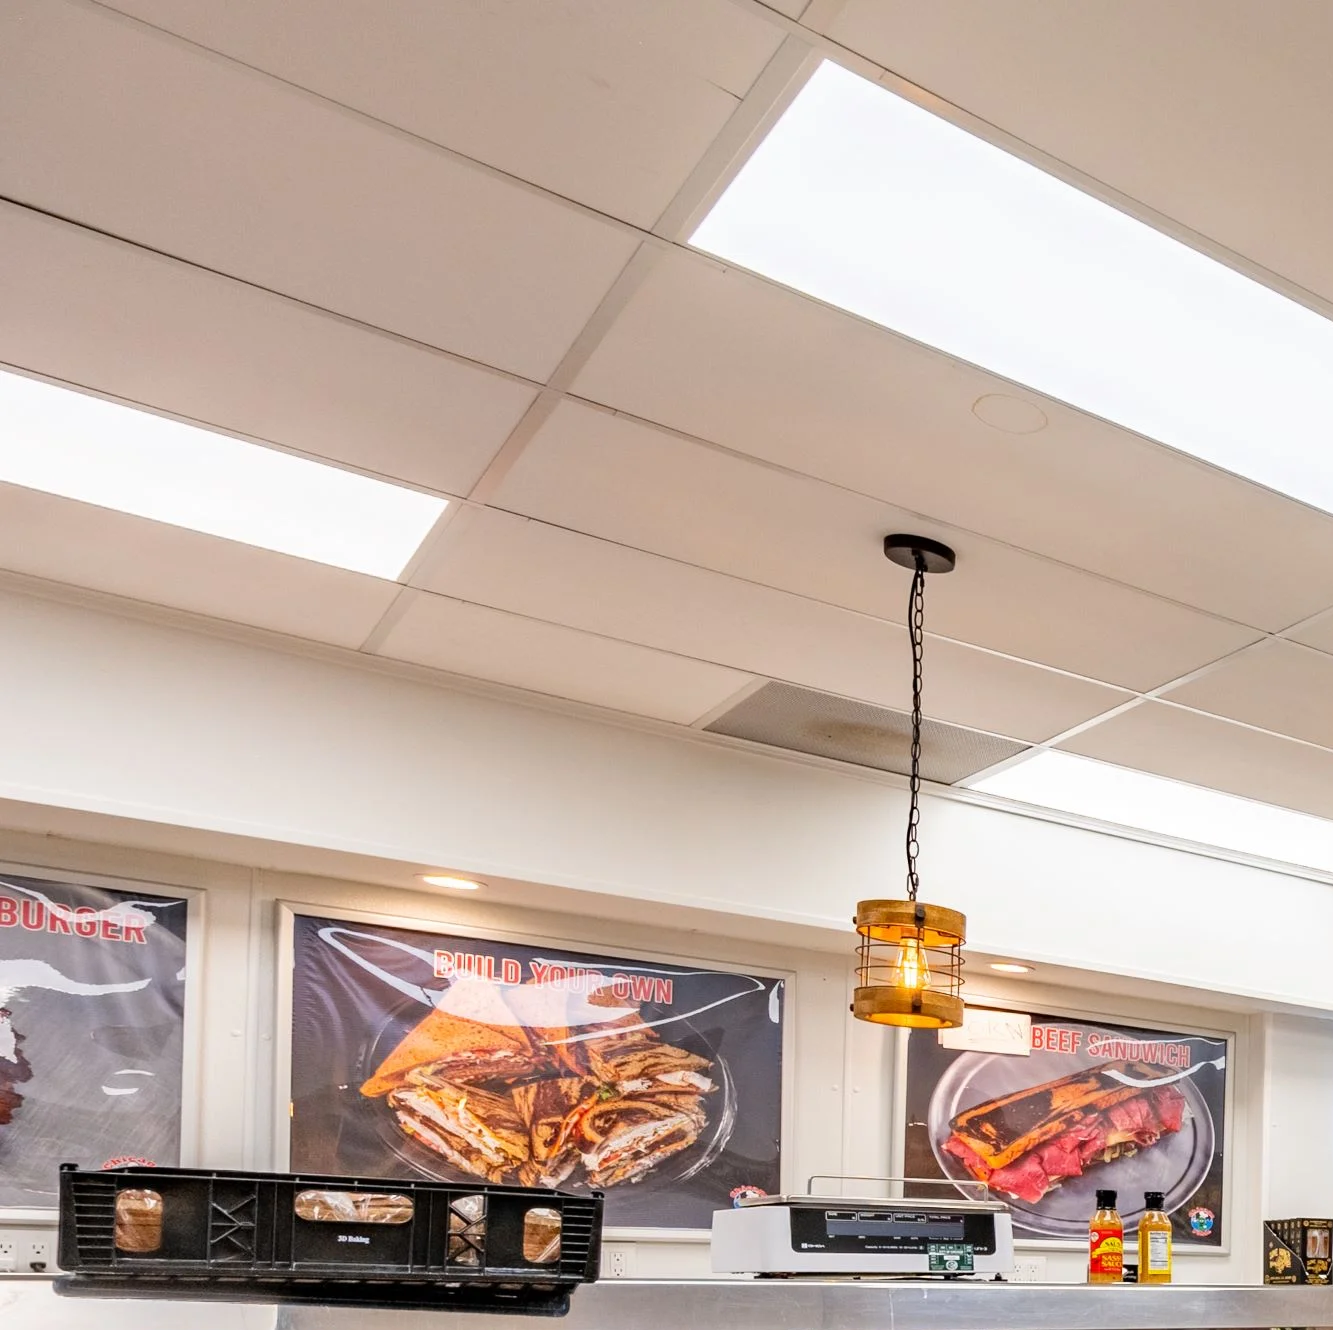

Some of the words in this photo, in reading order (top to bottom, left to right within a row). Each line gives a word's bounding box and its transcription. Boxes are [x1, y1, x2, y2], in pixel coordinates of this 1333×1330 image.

[0, 896, 148, 944] BURGER
[434, 949, 521, 986] BUILD
[528, 961, 605, 997] YOUR
[612, 973, 673, 1004] OWN
[1031, 1025, 1082, 1053] BEEF
[1088, 1033, 1191, 1067] SANDWICH
